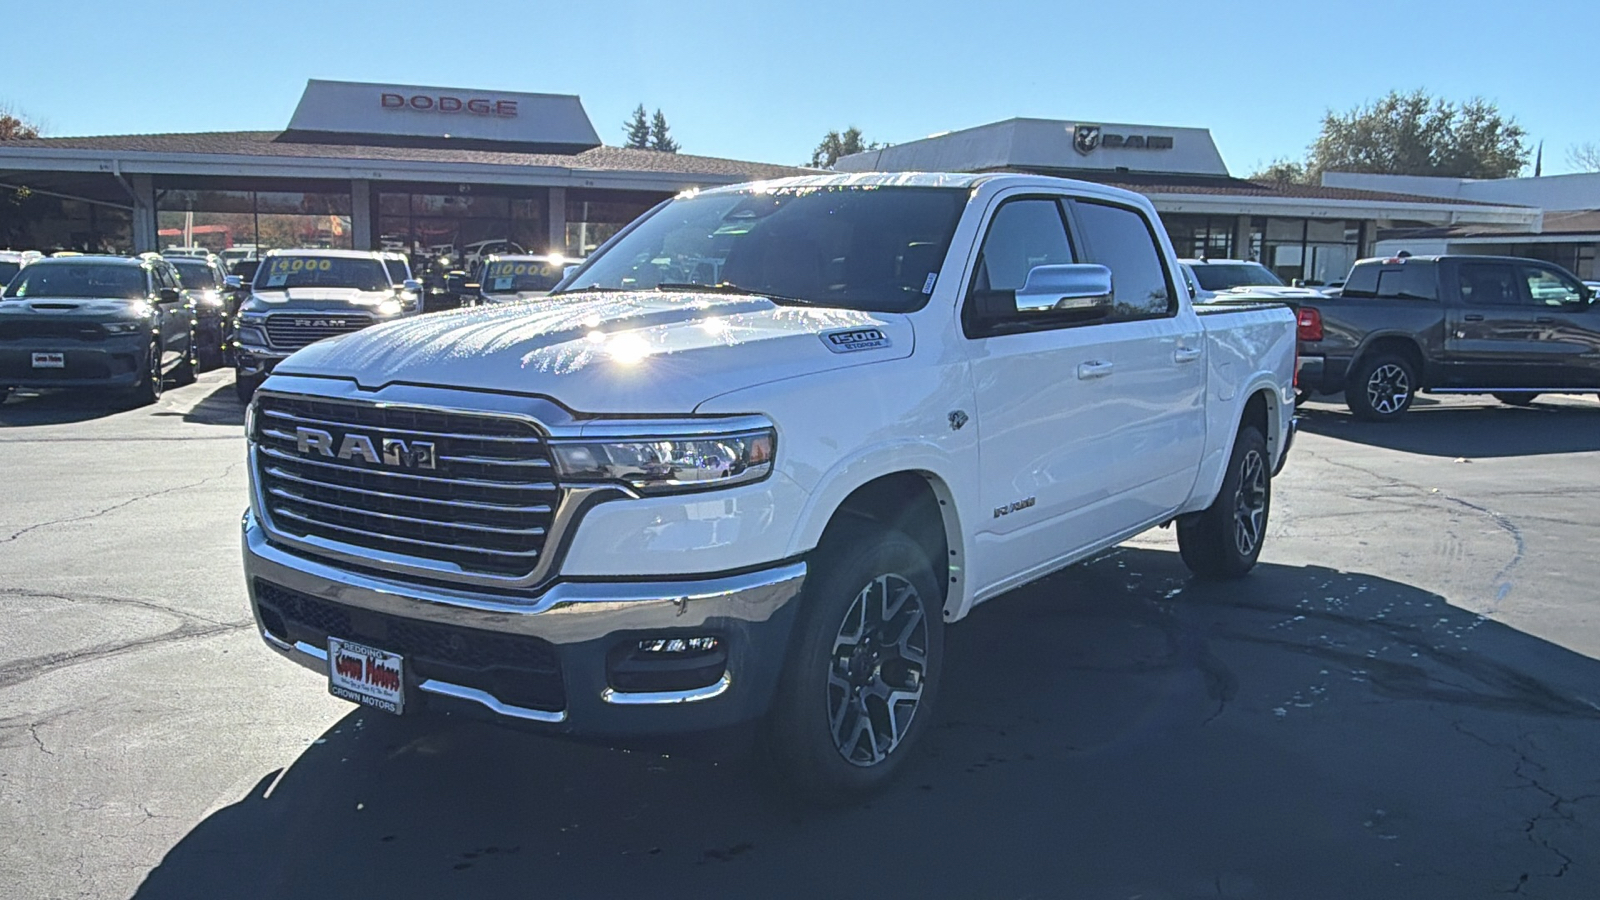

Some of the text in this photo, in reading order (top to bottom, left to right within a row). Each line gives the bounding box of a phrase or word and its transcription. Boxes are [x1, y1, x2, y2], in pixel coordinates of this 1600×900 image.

[381, 93, 518, 118] DODGE
[1101, 133, 1174, 150] RAM
[295, 319, 346, 328] RAM
[830, 329, 880, 344] 1500
[296, 426, 436, 470] RAM
[993, 495, 1036, 519] RAM
[343, 643, 383, 660] REDDING
[332, 686, 361, 702] CROWN
[361, 695, 396, 713] MOTORS
